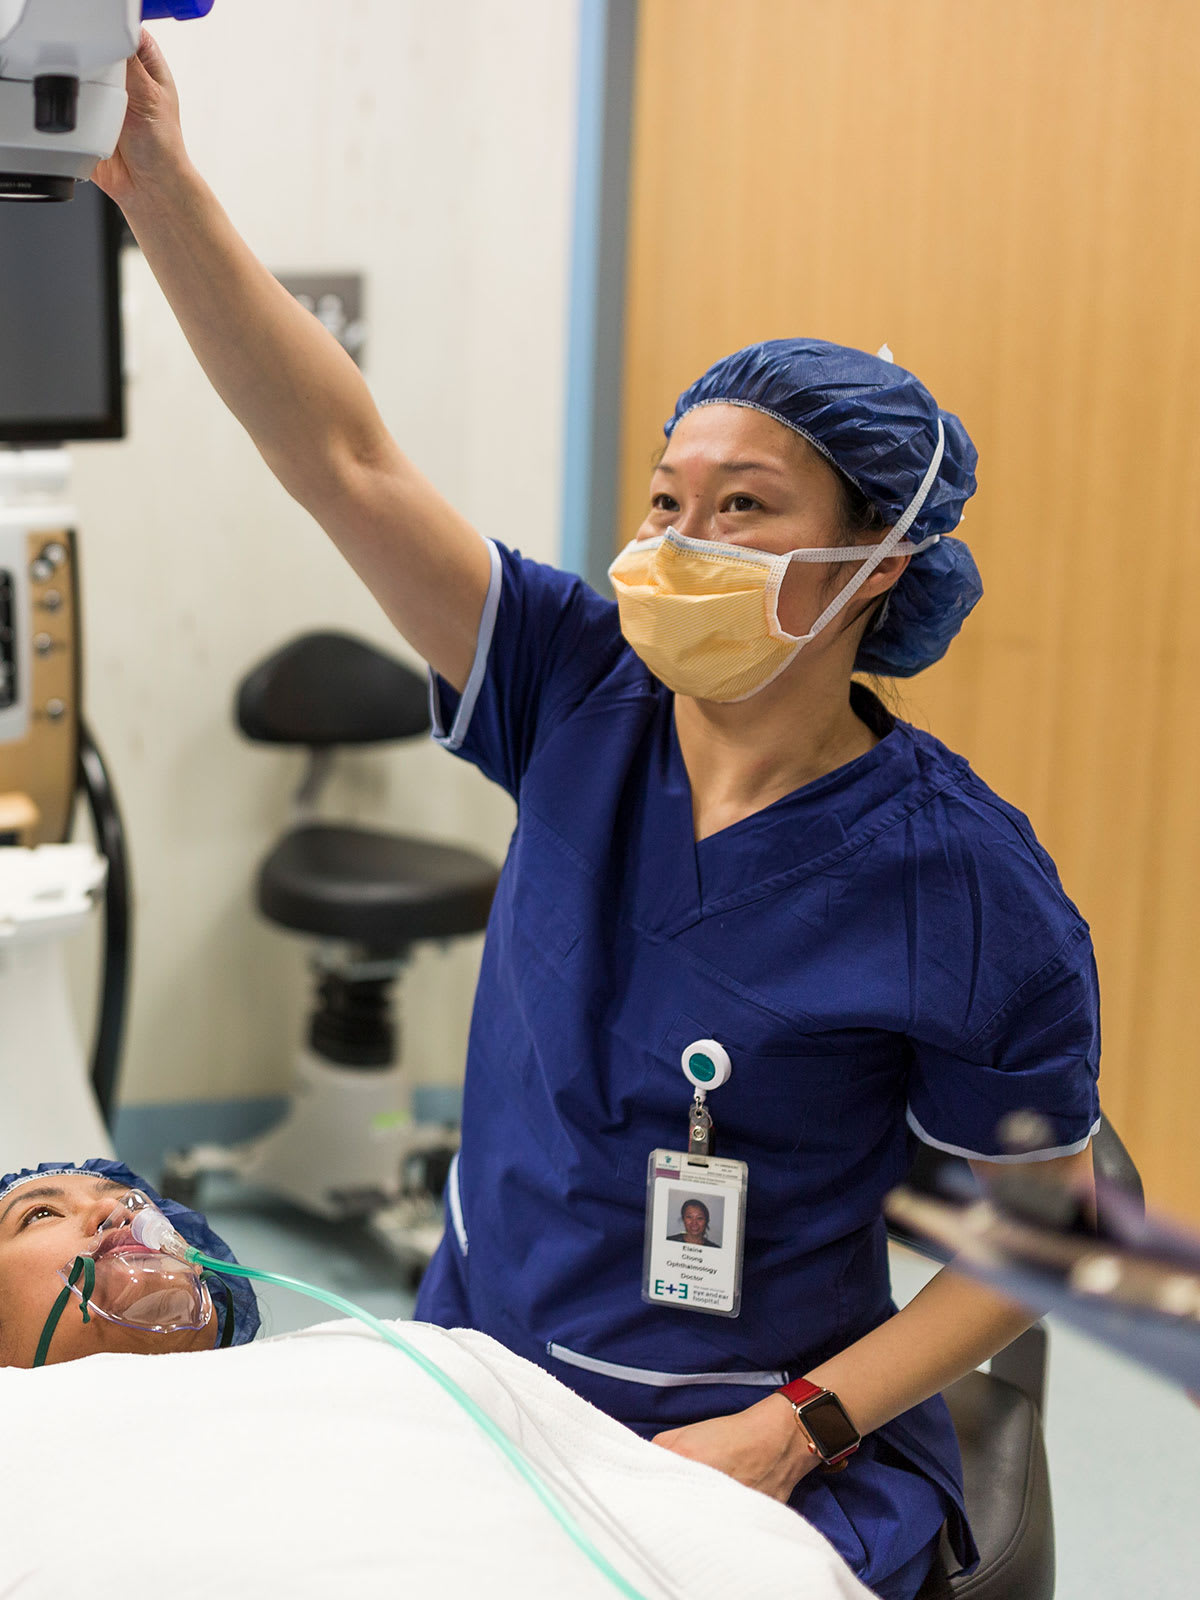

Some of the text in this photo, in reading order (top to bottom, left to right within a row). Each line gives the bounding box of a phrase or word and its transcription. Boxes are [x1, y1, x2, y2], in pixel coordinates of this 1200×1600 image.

[682, 1245, 703, 1253] Elaine
[681, 1253, 704, 1263] Chong
[666, 1260, 718, 1275] Ophthalmology
[680, 1272, 704, 1281] Doctor
[692, 1295, 720, 1305] hospital
